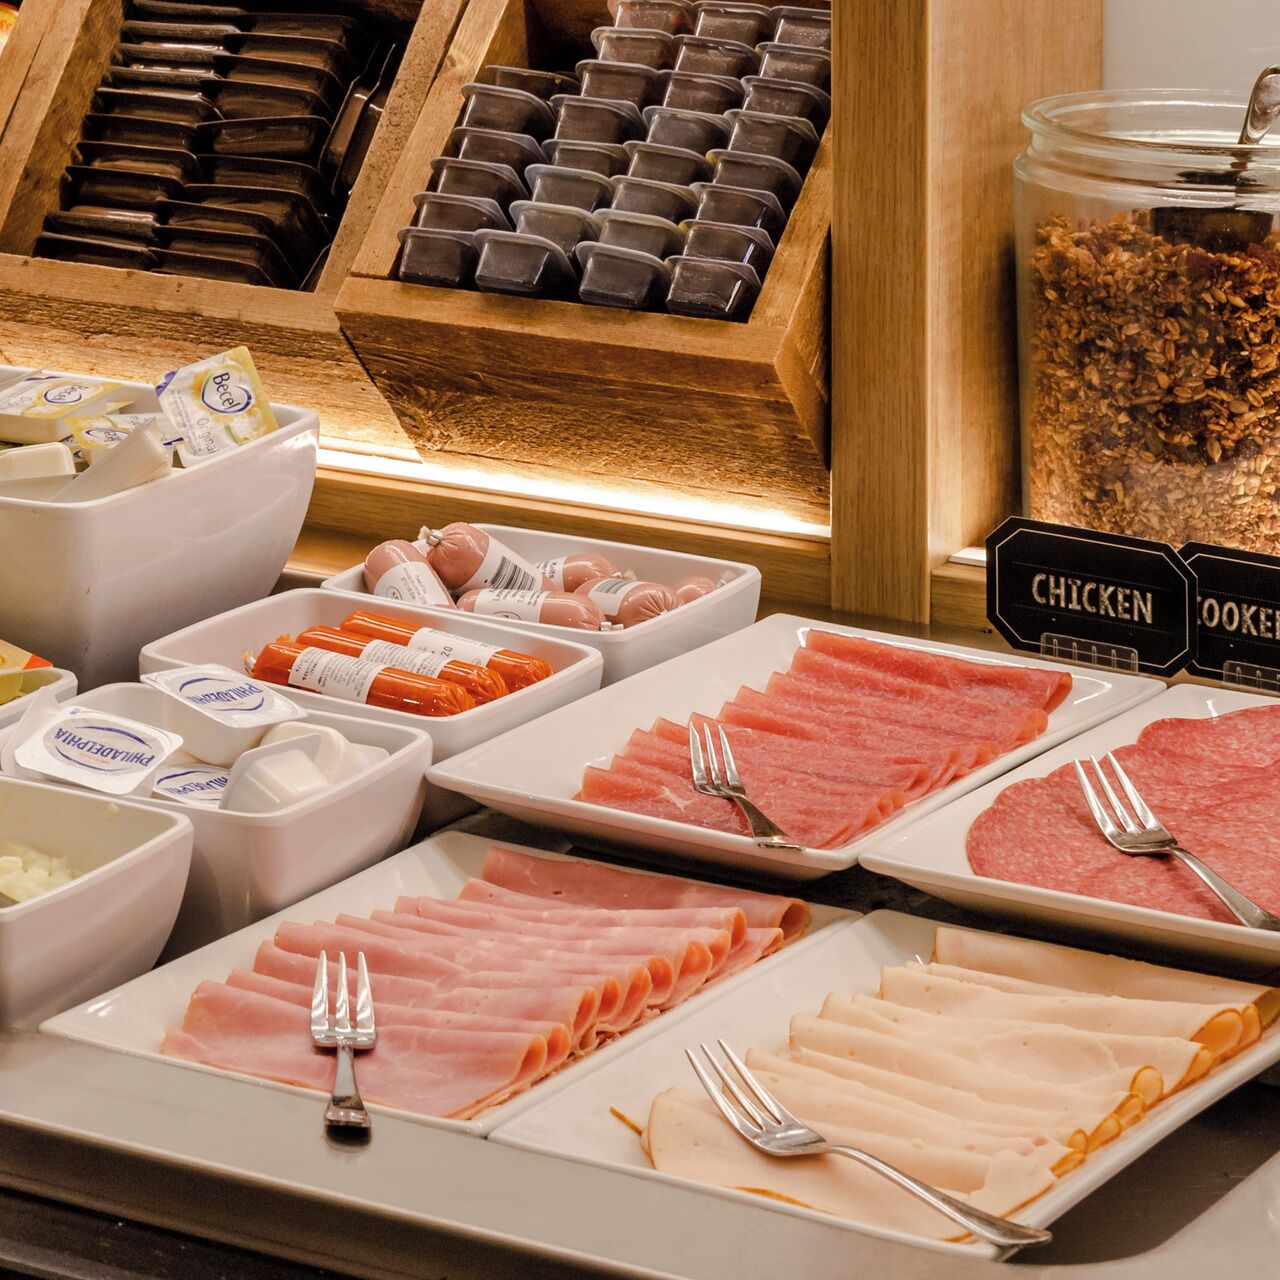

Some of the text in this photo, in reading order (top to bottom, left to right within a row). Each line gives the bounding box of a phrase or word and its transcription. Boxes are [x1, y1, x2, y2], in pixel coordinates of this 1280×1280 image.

[213, 372, 241, 411] Becel
[1032, 573, 1153, 624] CHICKEN
[1197, 596, 1280, 640] OOKE
[54, 727, 155, 767] PHILADELPHIA
